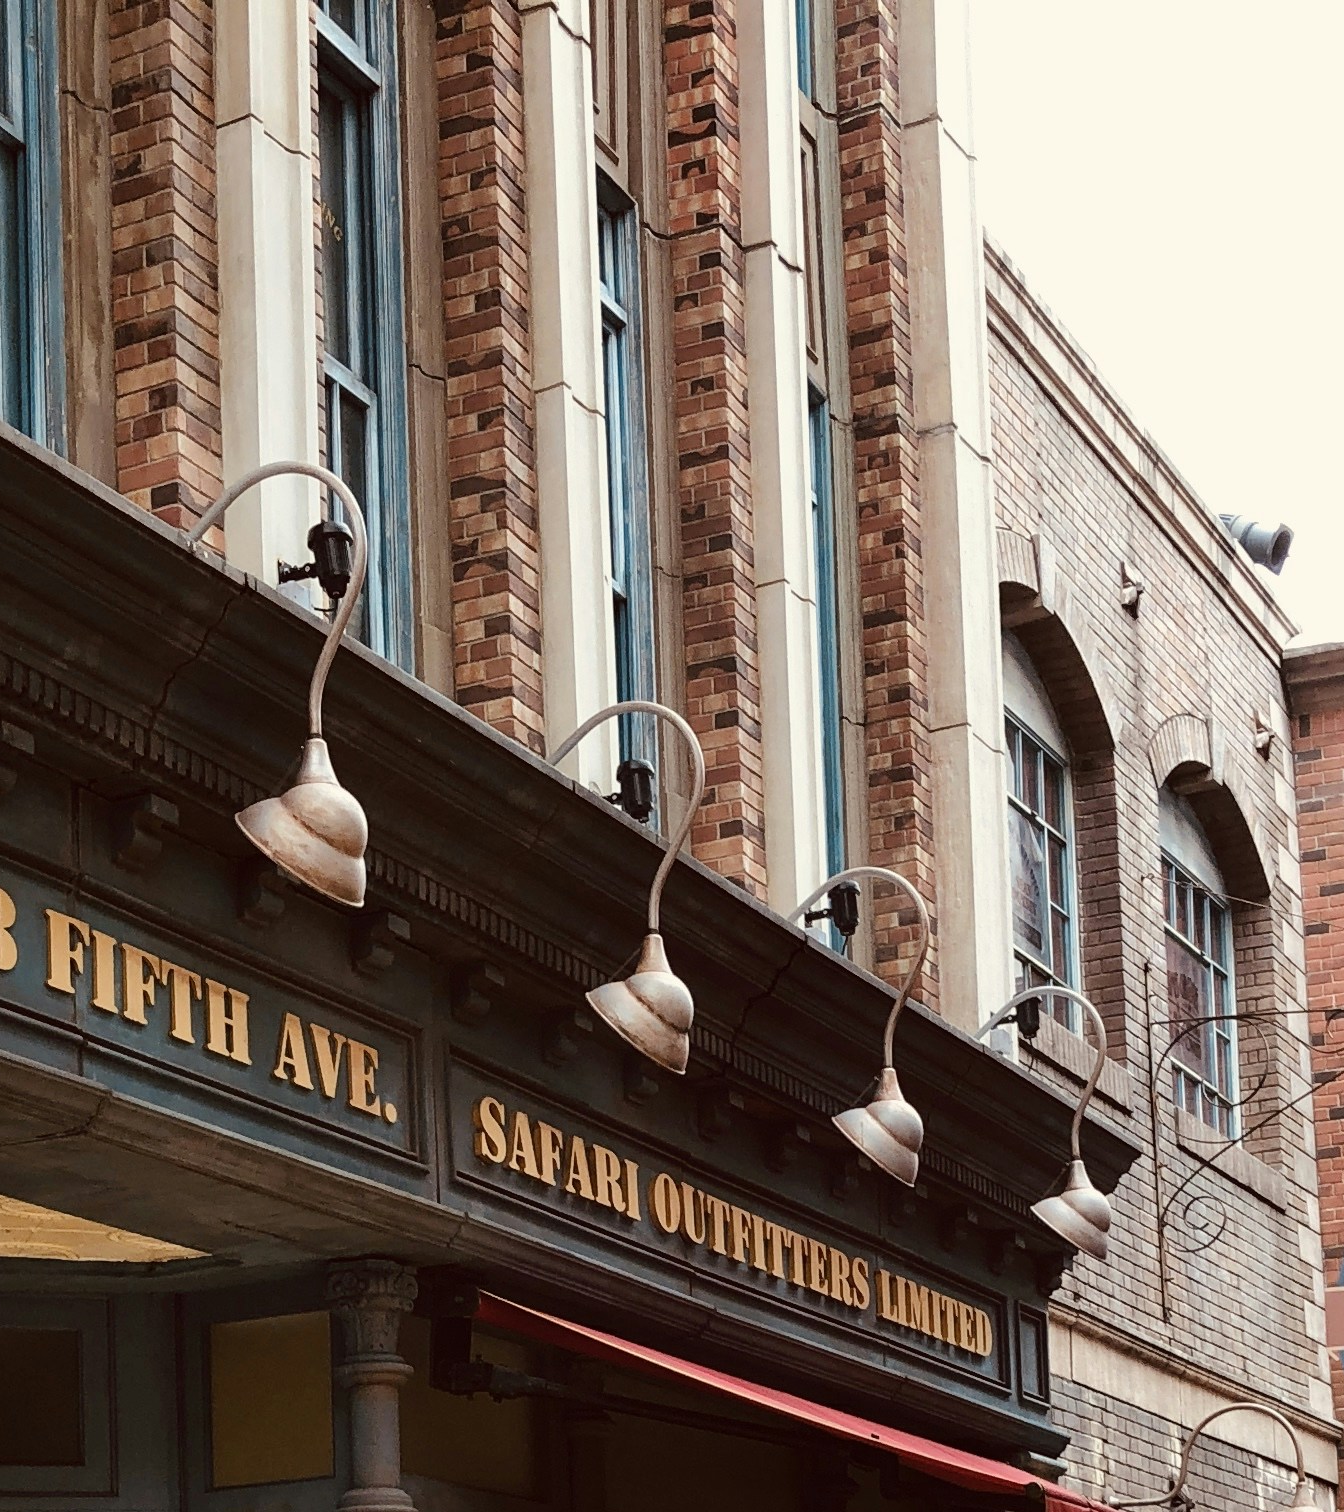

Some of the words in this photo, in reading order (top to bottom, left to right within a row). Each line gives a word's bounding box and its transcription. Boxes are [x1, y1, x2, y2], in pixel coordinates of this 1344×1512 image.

[44, 907, 254, 1066] FIFTH
[273, 1011, 399, 1125] AVE.
[473, 1095, 643, 1222] SAFARI
[649, 1172, 870, 1311] OUTFITTERS
[875, 1268, 994, 1358] LIMITED
